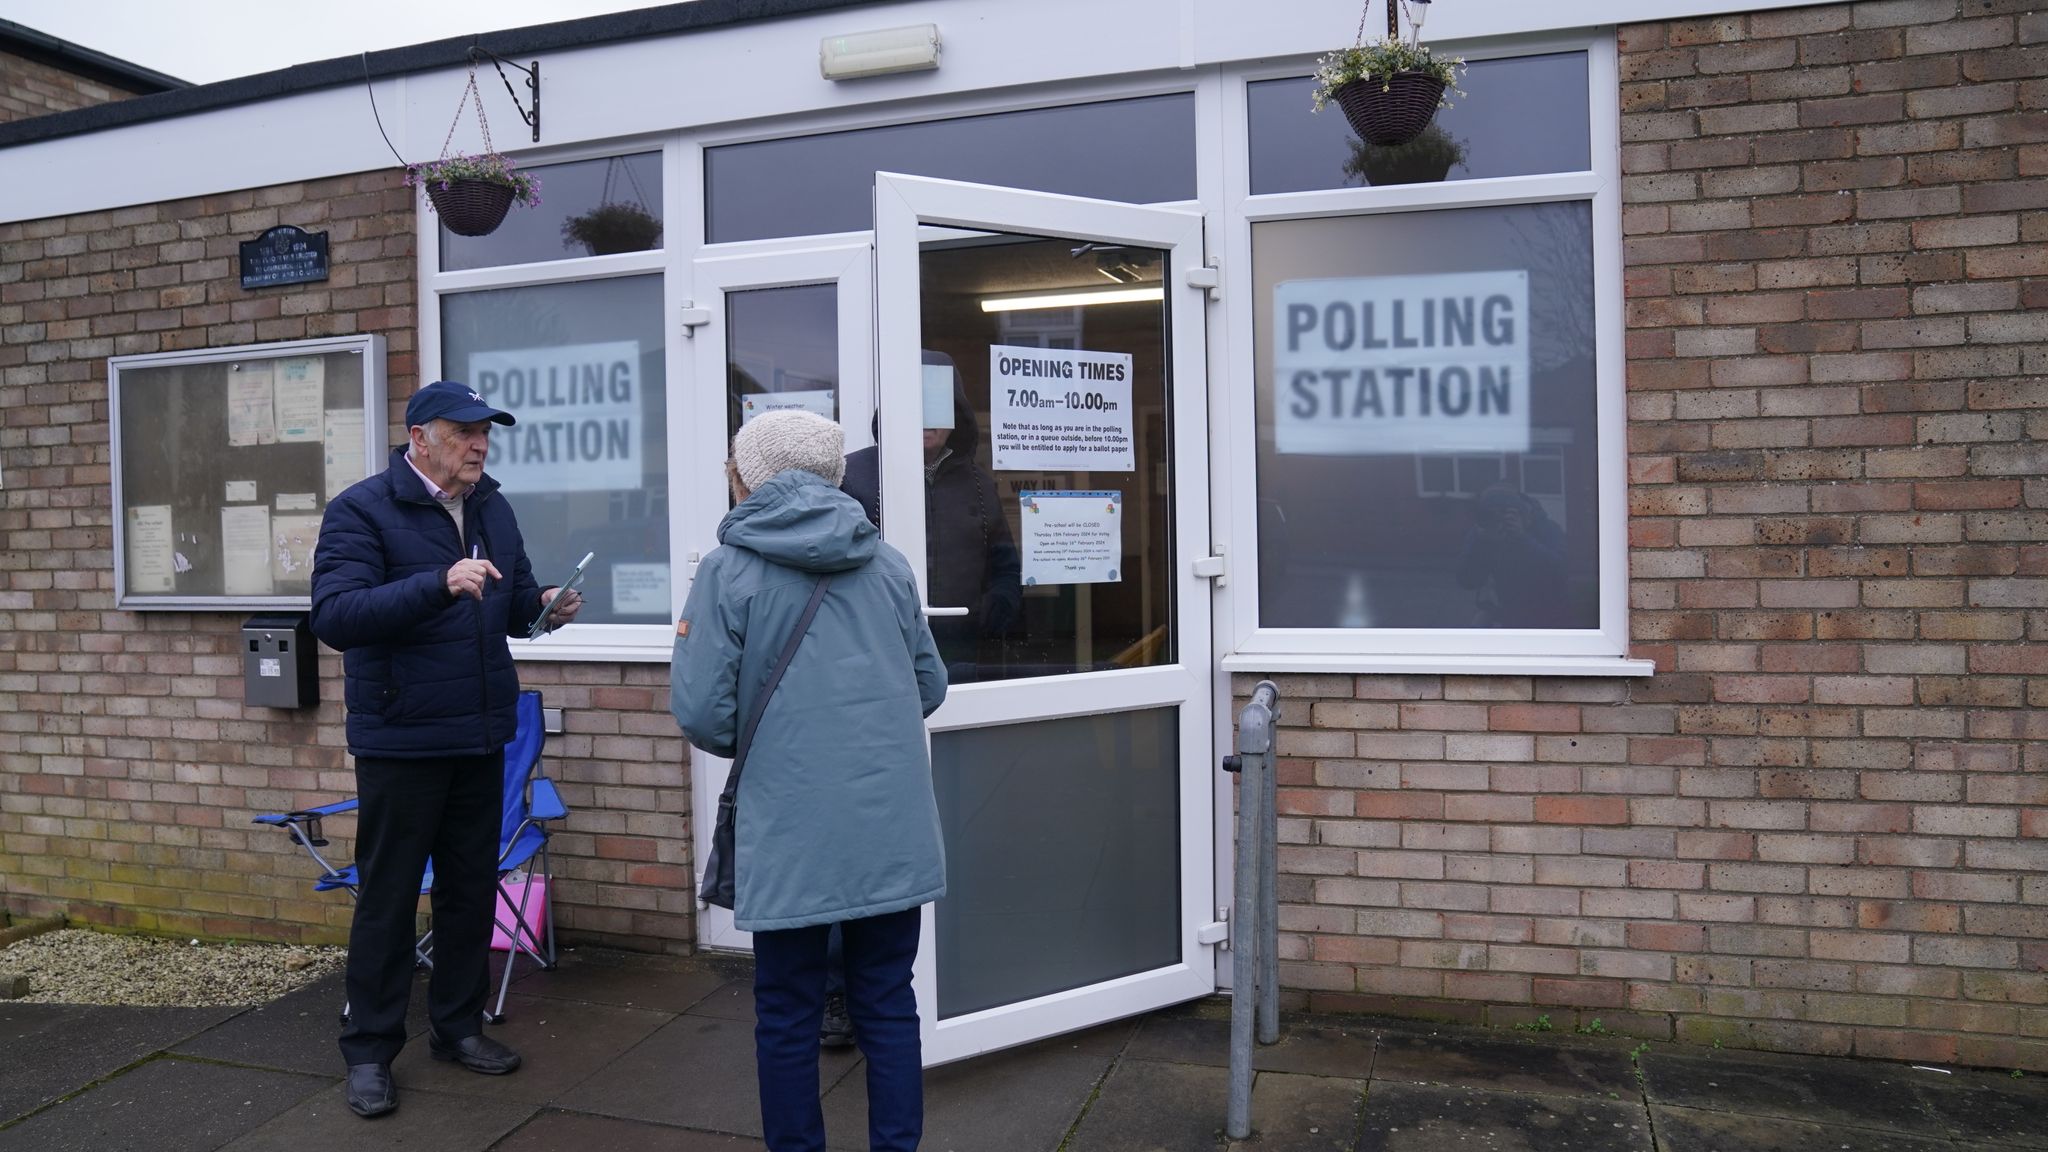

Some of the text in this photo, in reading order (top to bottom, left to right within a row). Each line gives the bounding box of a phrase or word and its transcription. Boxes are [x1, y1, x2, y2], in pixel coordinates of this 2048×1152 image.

[1287, 294, 1515, 353] POLLING
[1000, 357, 1125, 381] OPENING TIMES
[479, 361, 631, 409] POLLING
[1290, 366, 1511, 420] STATION
[997, 433, 1020, 441] station,
[1041, 435, 1059, 443] queue
[1040, 424, 1053, 432] long
[1103, 426, 1122, 434] polling
[485, 419, 630, 466] STATION
[1063, 445, 1078, 453] apply
[1011, 480, 1056, 491] WAY IN
